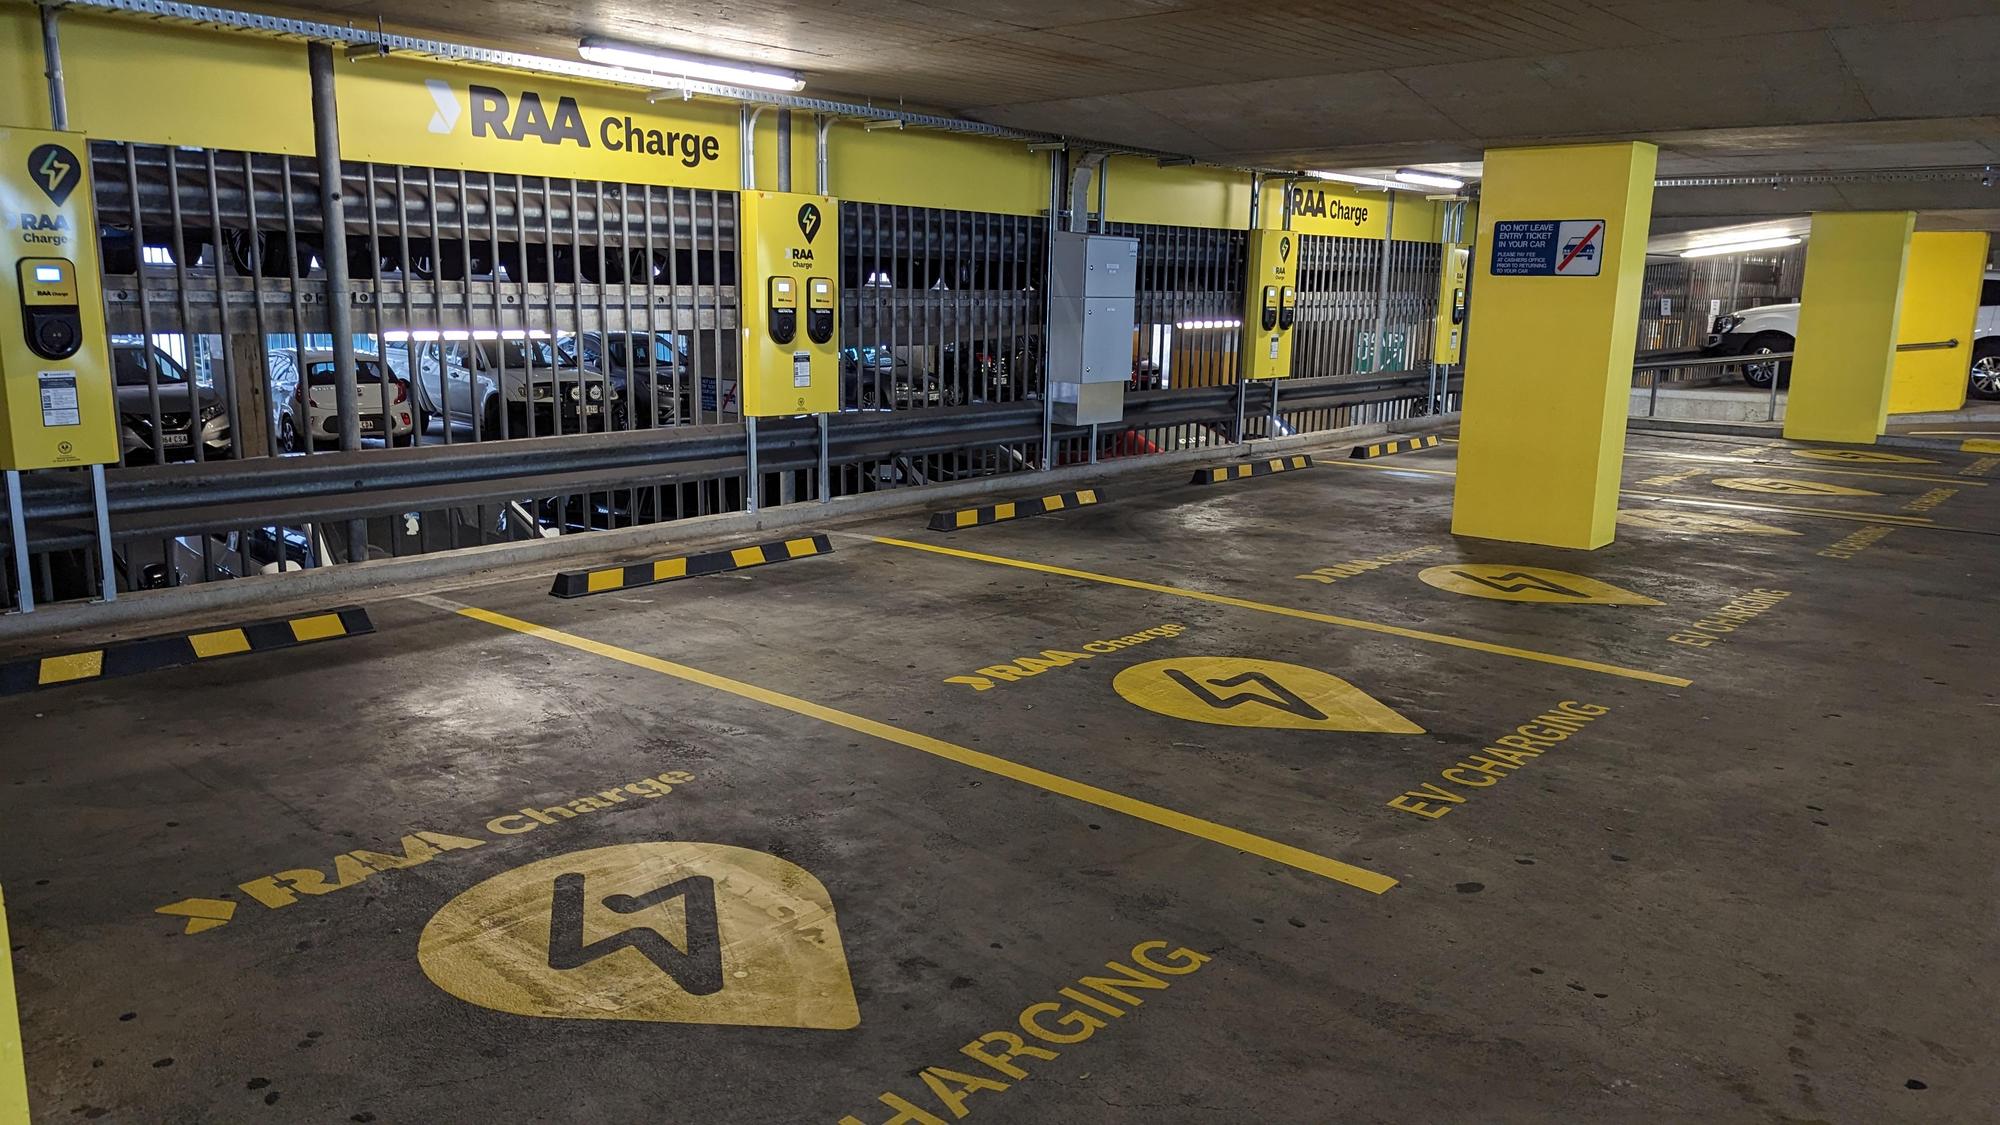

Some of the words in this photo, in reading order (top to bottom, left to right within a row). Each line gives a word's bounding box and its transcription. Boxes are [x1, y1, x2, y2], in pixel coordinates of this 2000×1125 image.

[469, 84, 591, 148] RAA
[600, 116, 719, 168] Charge
[21, 213, 70, 231] RAA
[1292, 188, 1327, 218] RAA
[1329, 200, 1368, 226] Charge
[23, 233, 70, 246] Charge
[792, 248, 814, 260] RAA
[1500, 232, 1524, 240] ENTRY
[1525, 232, 1552, 240] TICKET
[792, 261, 813, 270] Charge
[1693, 588, 1793, 632] CHARGING
[974, 649, 1097, 682] RAA
[1082, 623, 1188, 653] Charge
[1666, 629, 1721, 649] EV
[1386, 782, 1467, 820] EV
[1441, 700, 1611, 787] CHARGING
[238, 831, 488, 910] RAA
[486, 770, 697, 835] Charge
[837, 939, 1213, 1125] HARGING
